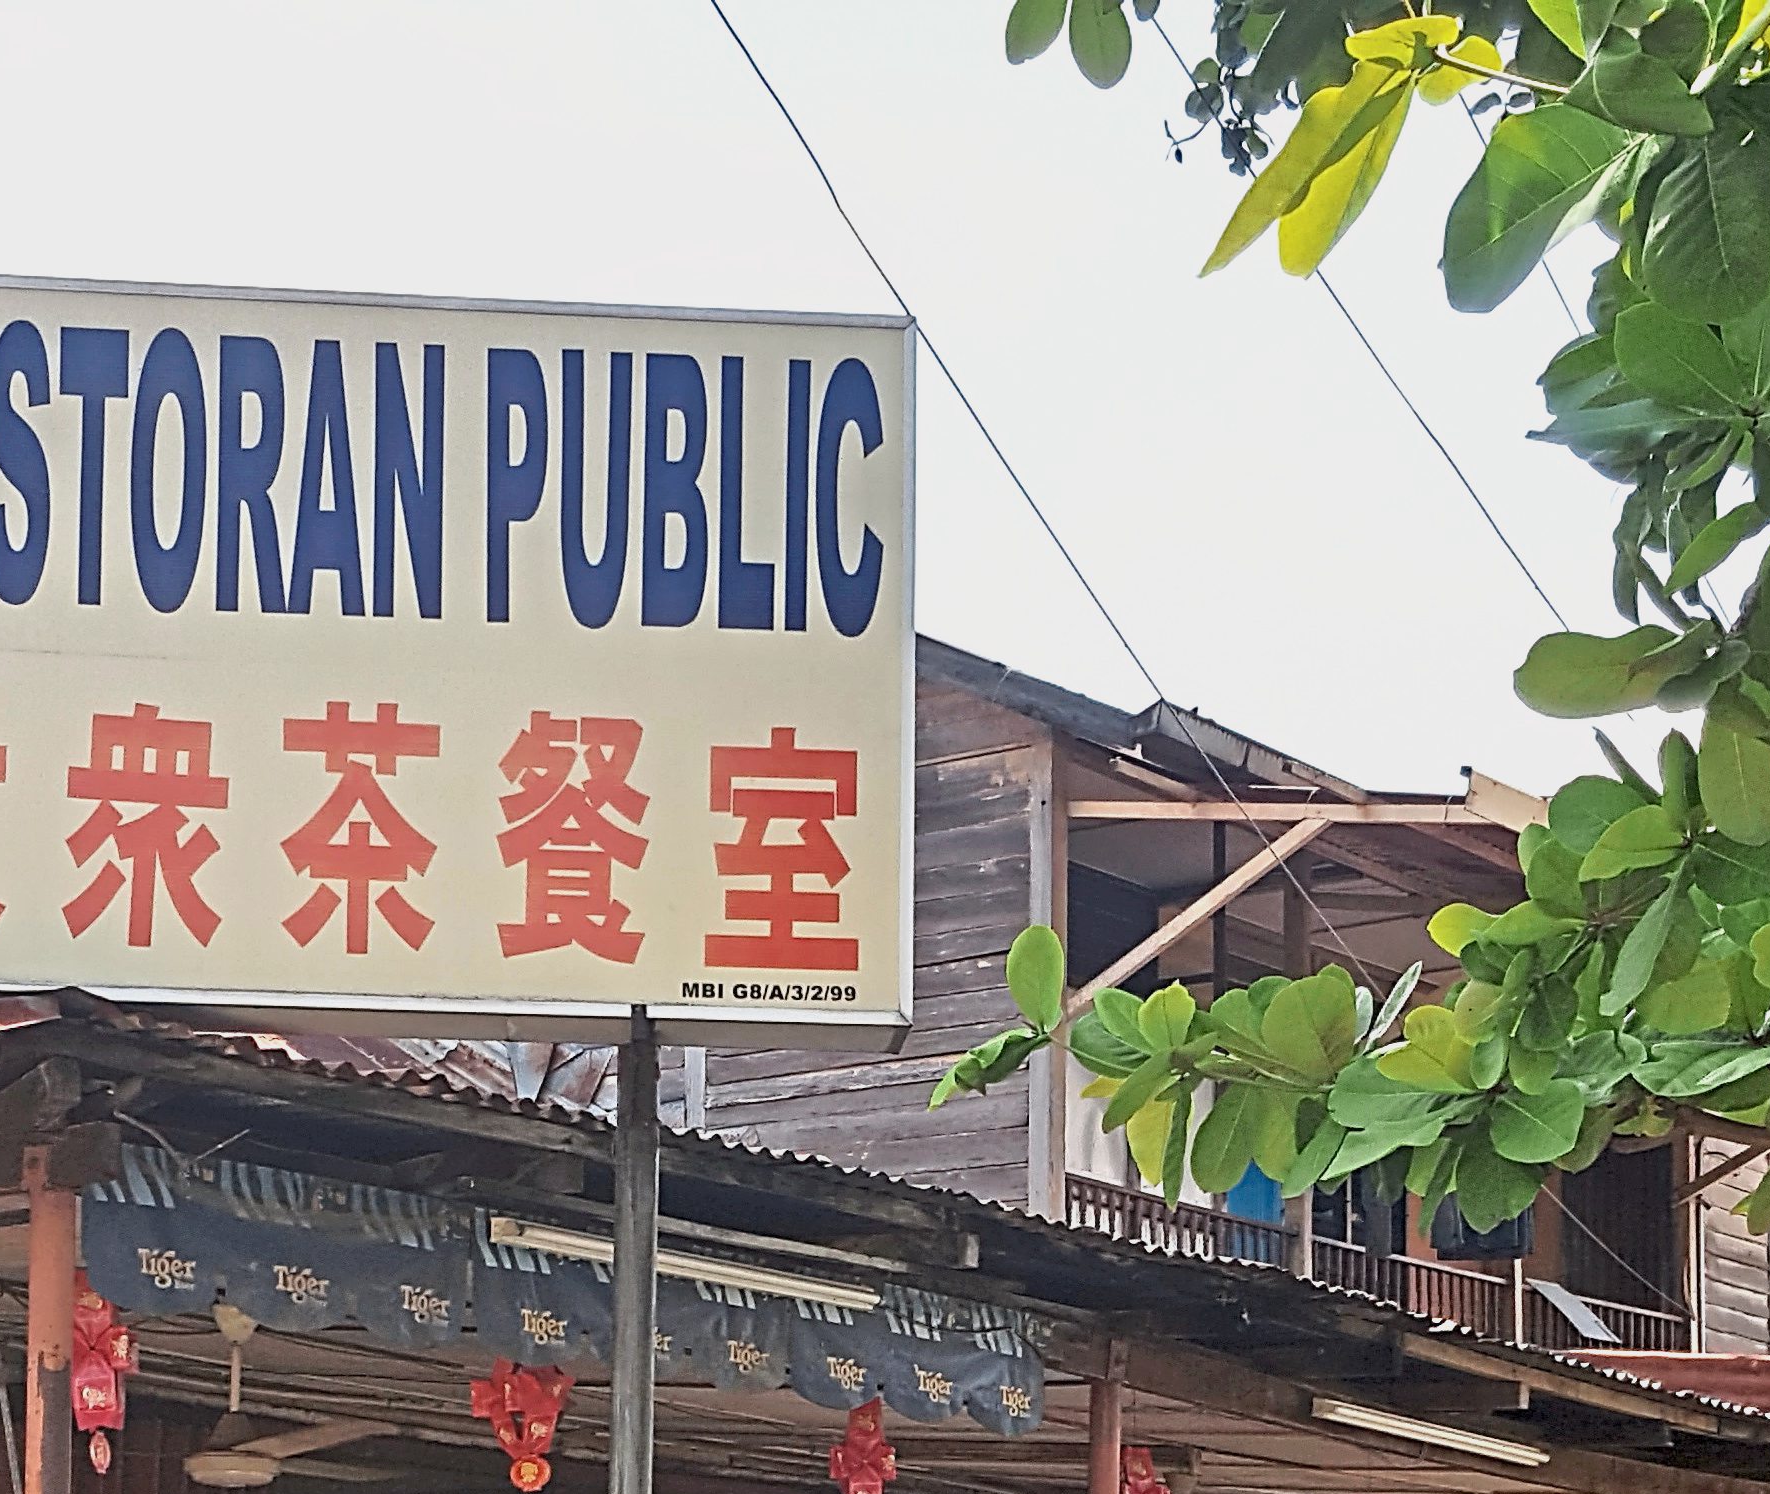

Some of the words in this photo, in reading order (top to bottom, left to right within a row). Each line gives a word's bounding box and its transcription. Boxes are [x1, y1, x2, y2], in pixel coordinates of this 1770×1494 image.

[487, 348, 884, 638] PUBLIC
[682, 983, 723, 998] MBI
[733, 984, 856, 1000] G8/A/3/2/99
[138, 1248, 196, 1288] Tiger
[274, 1265, 328, 1303] Tiger
[400, 1285, 450, 1323] Tiger
[521, 1309, 568, 1344] Tiger
[728, 1340, 769, 1373] Tiger
[827, 1357, 867, 1390] Tiger
[917, 1370, 953, 1402] Tiger
